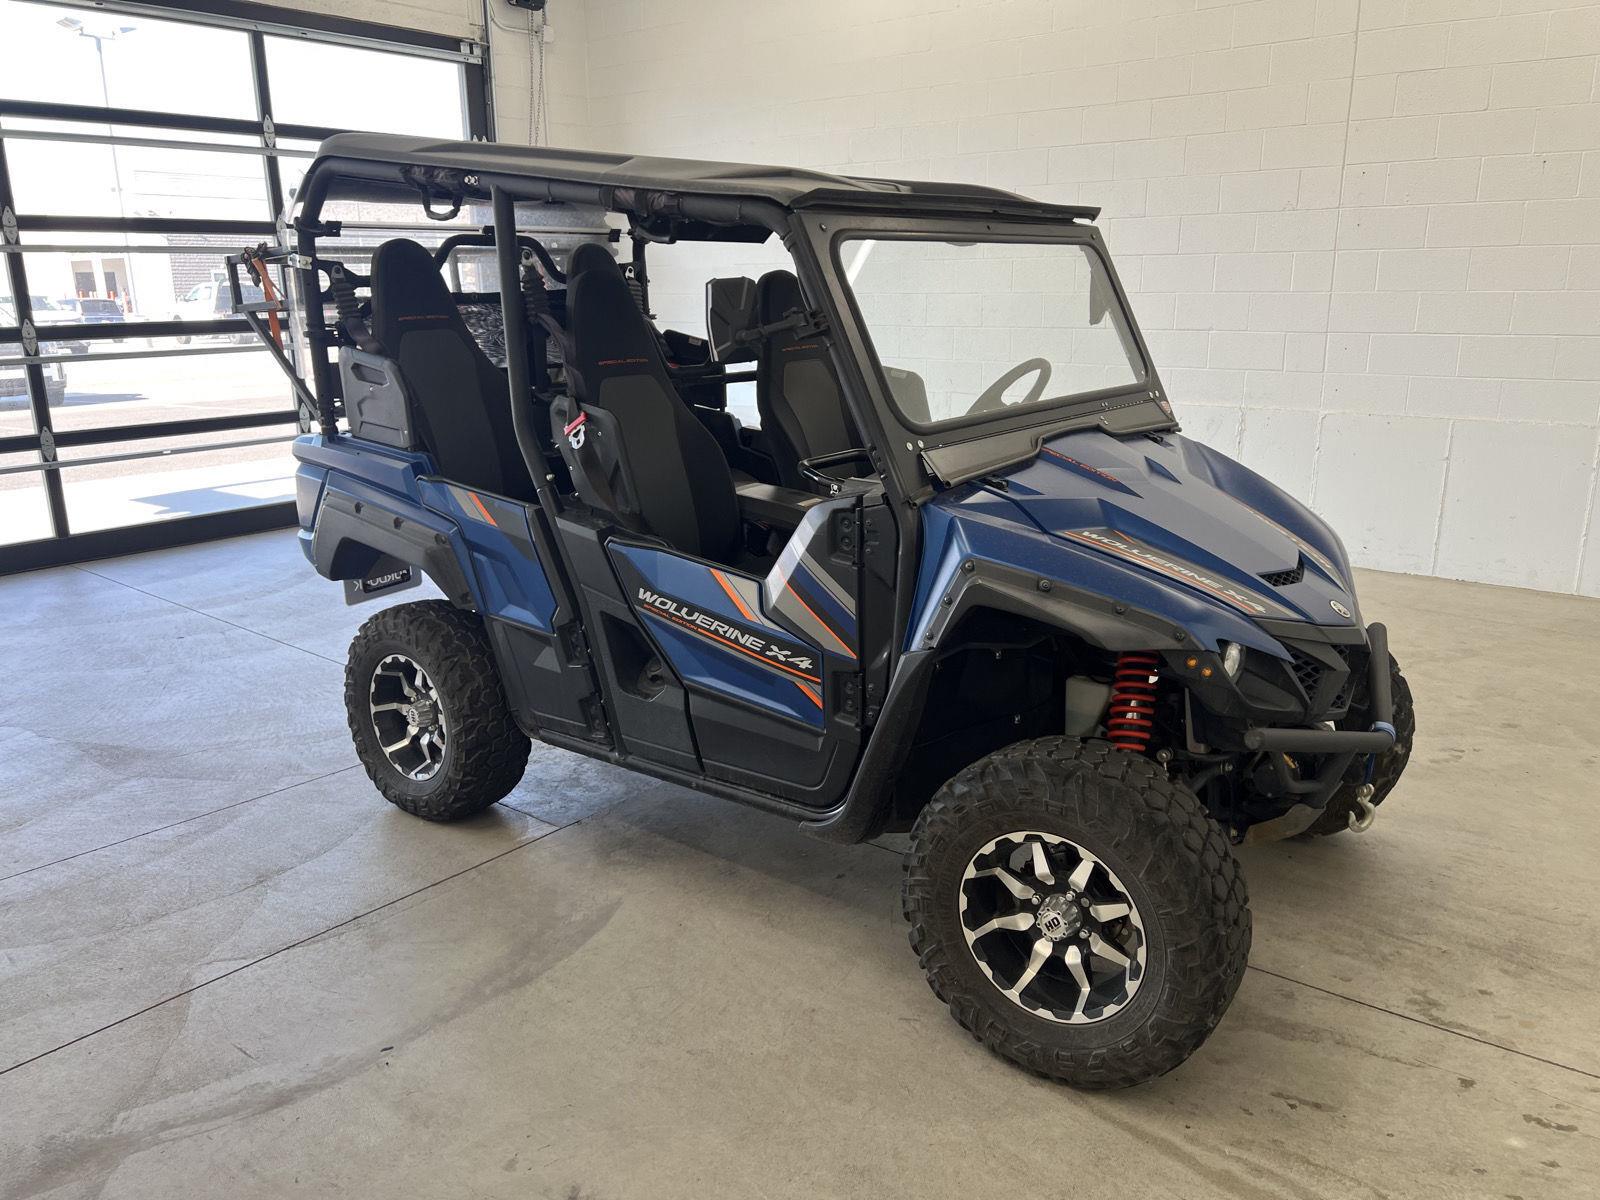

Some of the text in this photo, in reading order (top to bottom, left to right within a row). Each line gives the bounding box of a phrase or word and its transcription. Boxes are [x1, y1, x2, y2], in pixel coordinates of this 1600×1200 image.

[1081, 530, 1267, 614] WOLVERINE X4
[638, 587, 814, 670] WOLVERINE X4
[643, 603, 698, 631] SPECIAL EDITION
[1044, 916, 1061, 932] HD
